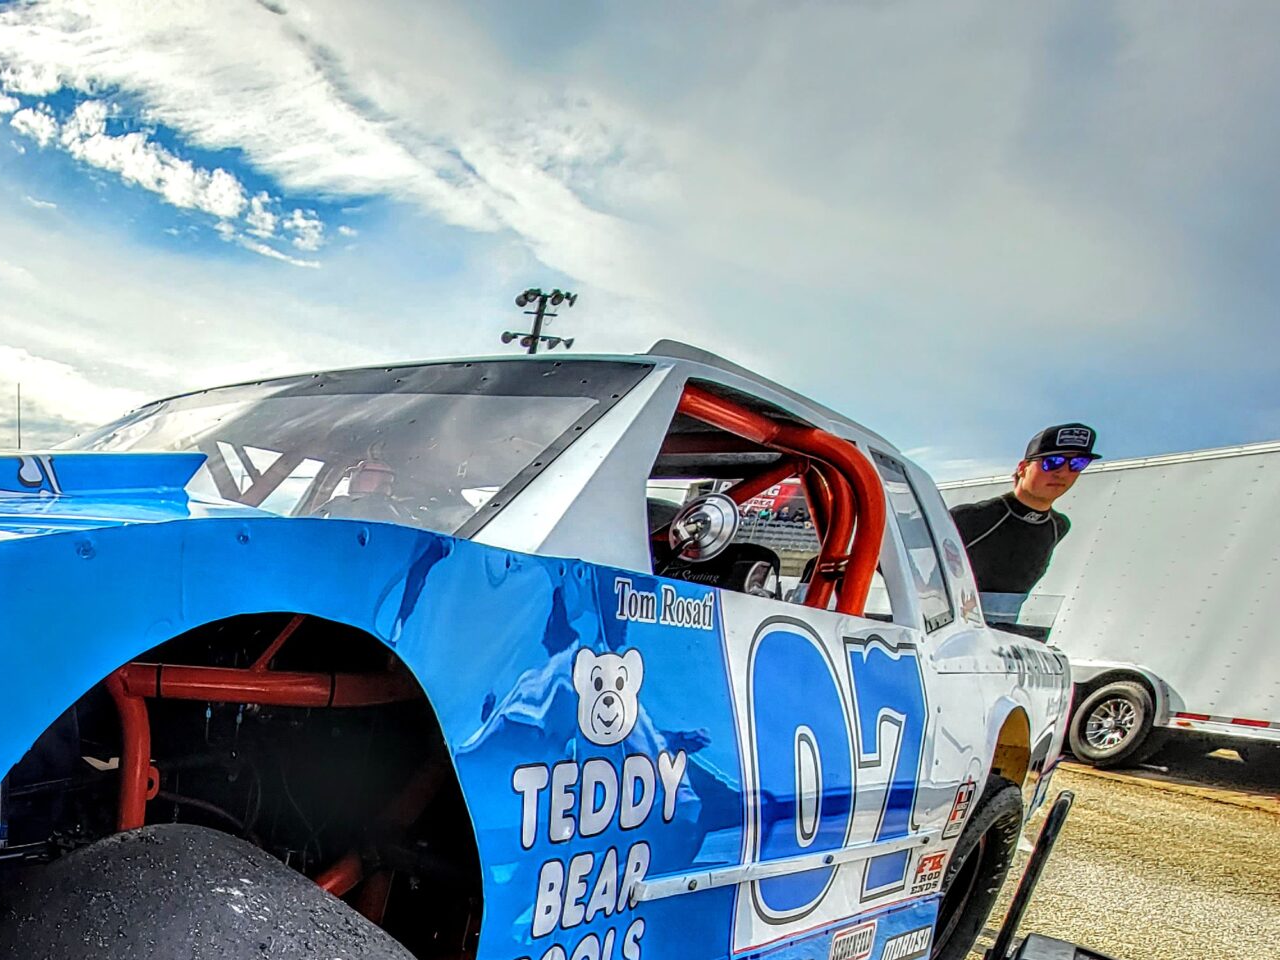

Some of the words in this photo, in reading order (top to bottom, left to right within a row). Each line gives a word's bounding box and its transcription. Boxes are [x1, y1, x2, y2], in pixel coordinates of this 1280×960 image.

[615, 578, 656, 621] Tom
[660, 584, 714, 629] Rosati
[746, 614, 929, 925] 07
[512, 749, 687, 850] TEDDY
[531, 839, 651, 939] BEAR
[910, 881, 939, 895] ENDS
[917, 853, 946, 875] FK
[920, 871, 941, 883] ROD
